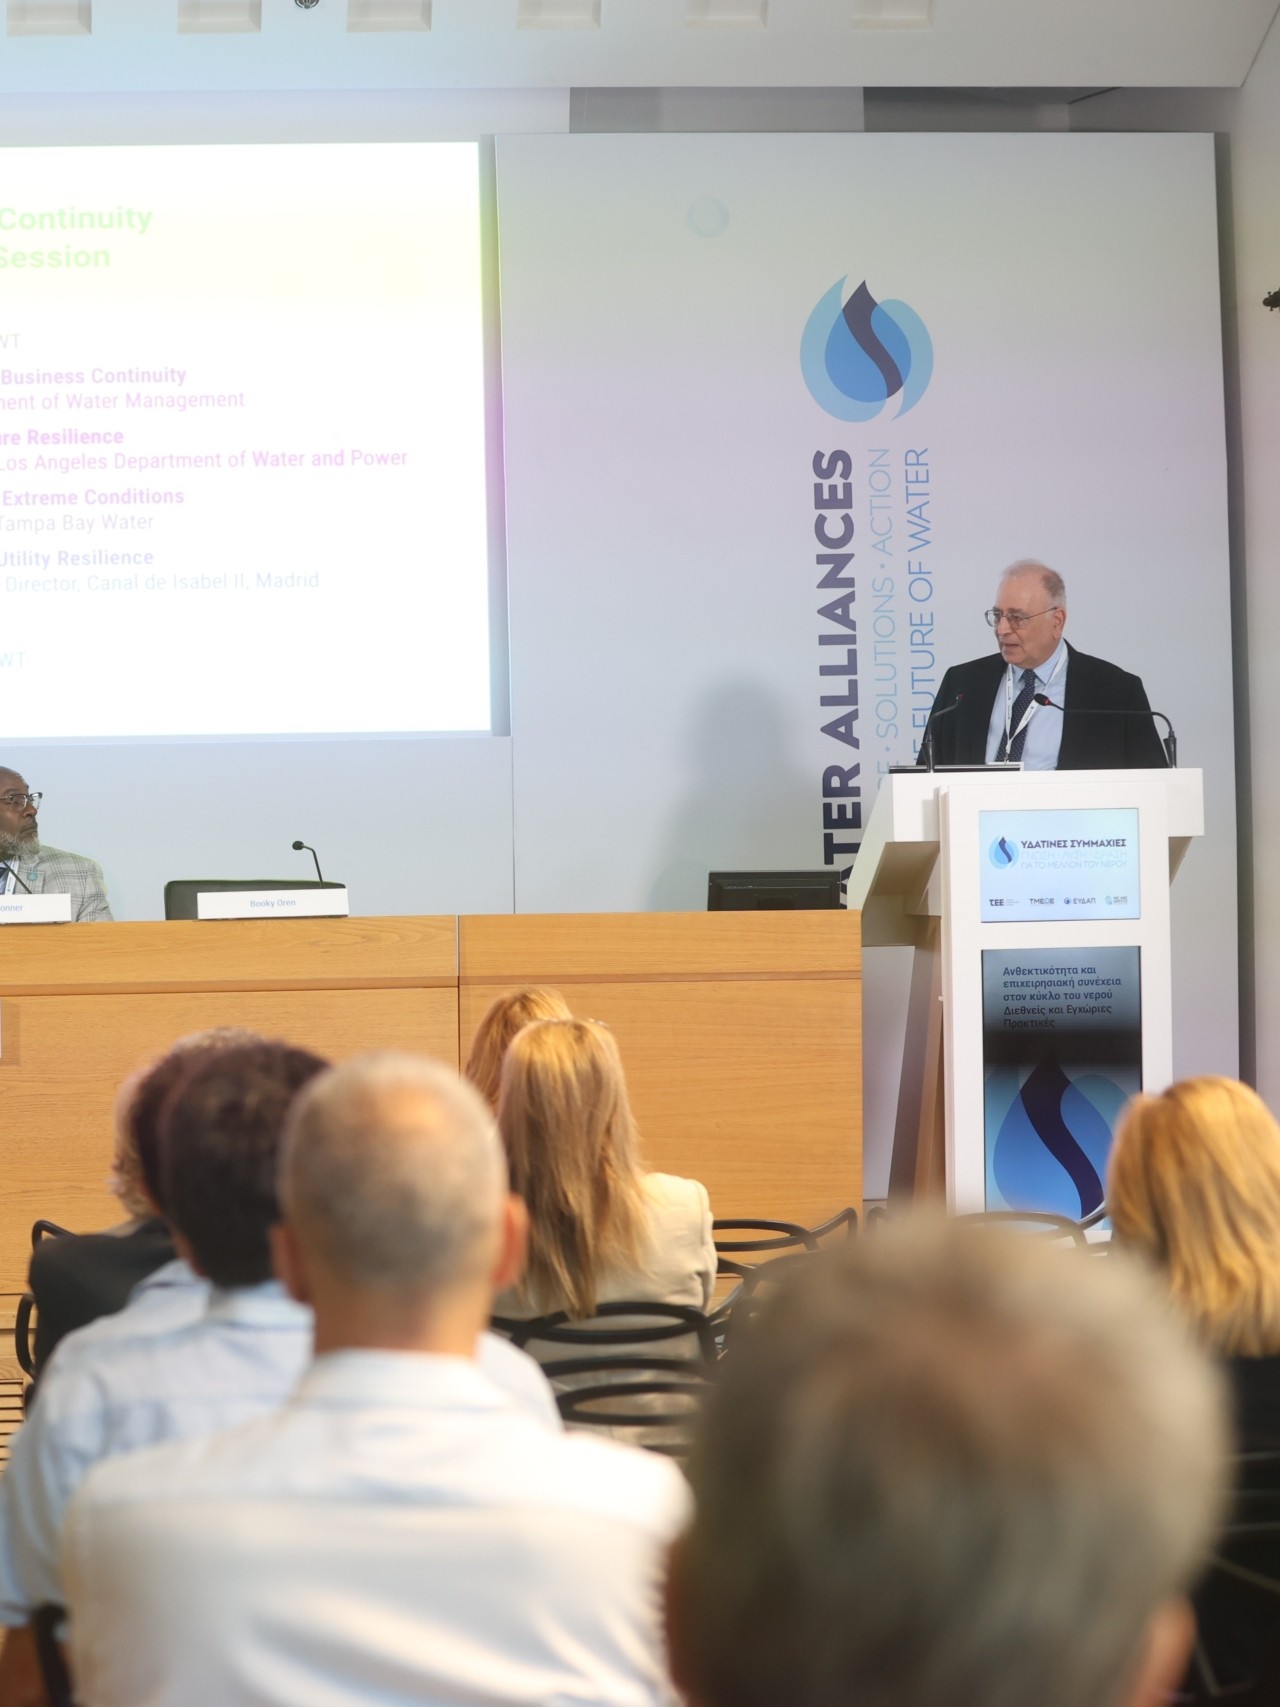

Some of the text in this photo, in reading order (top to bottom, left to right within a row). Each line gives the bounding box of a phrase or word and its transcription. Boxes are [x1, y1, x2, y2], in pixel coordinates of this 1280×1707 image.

[1, 369, 85, 385] Business
[91, 367, 186, 385] Continuity
[42, 392, 59, 410] of
[66, 393, 119, 409] Water
[125, 389, 245, 411] Management
[27, 429, 124, 445] Resilience
[34, 454, 107, 474] Angeles
[114, 452, 221, 471] Department
[228, 450, 246, 467] of
[252, 451, 305, 467] Water
[312, 449, 345, 467] and
[351, 450, 408, 466] Power
[2, 490, 78, 506] Extreme
[84, 488, 184, 505] Conditions
[868, 448, 894, 557] ACTION
[63, 515, 95, 534] Bay
[101, 514, 154, 530] Water
[58, 550, 154, 565] Resilience
[5, 576, 80, 592] Director,
[87, 575, 138, 591] Canal
[145, 574, 166, 591] de
[173, 574, 230, 590] Isabel
[256, 571, 319, 588] Madrid
[904, 448, 935, 728] FUTURE OF WATER
[812, 449, 860, 750] ALLIANCES
[871, 576, 899, 739] SOLUTIONS
[1021, 838, 1127, 849] ΥΔΑΤΙΝΕΣ ΣΥΜΜΑΧΙΕΣ
[250, 899, 296, 909] Booky Oren
[1003, 965, 1096, 978] Ανθεκτικότητα και
[1003, 976, 1122, 989] επιχειρησιακή συνέχεια
[1030, 990, 1060, 1000] κύκλο
[1063, 992, 1081, 1000] του
[1084, 989, 1113, 1000] νερού
[1004, 1004, 1112, 1016] Διεθνείς και Εγχώριες
[1004, 1018, 1055, 1029] Πρακτικές
